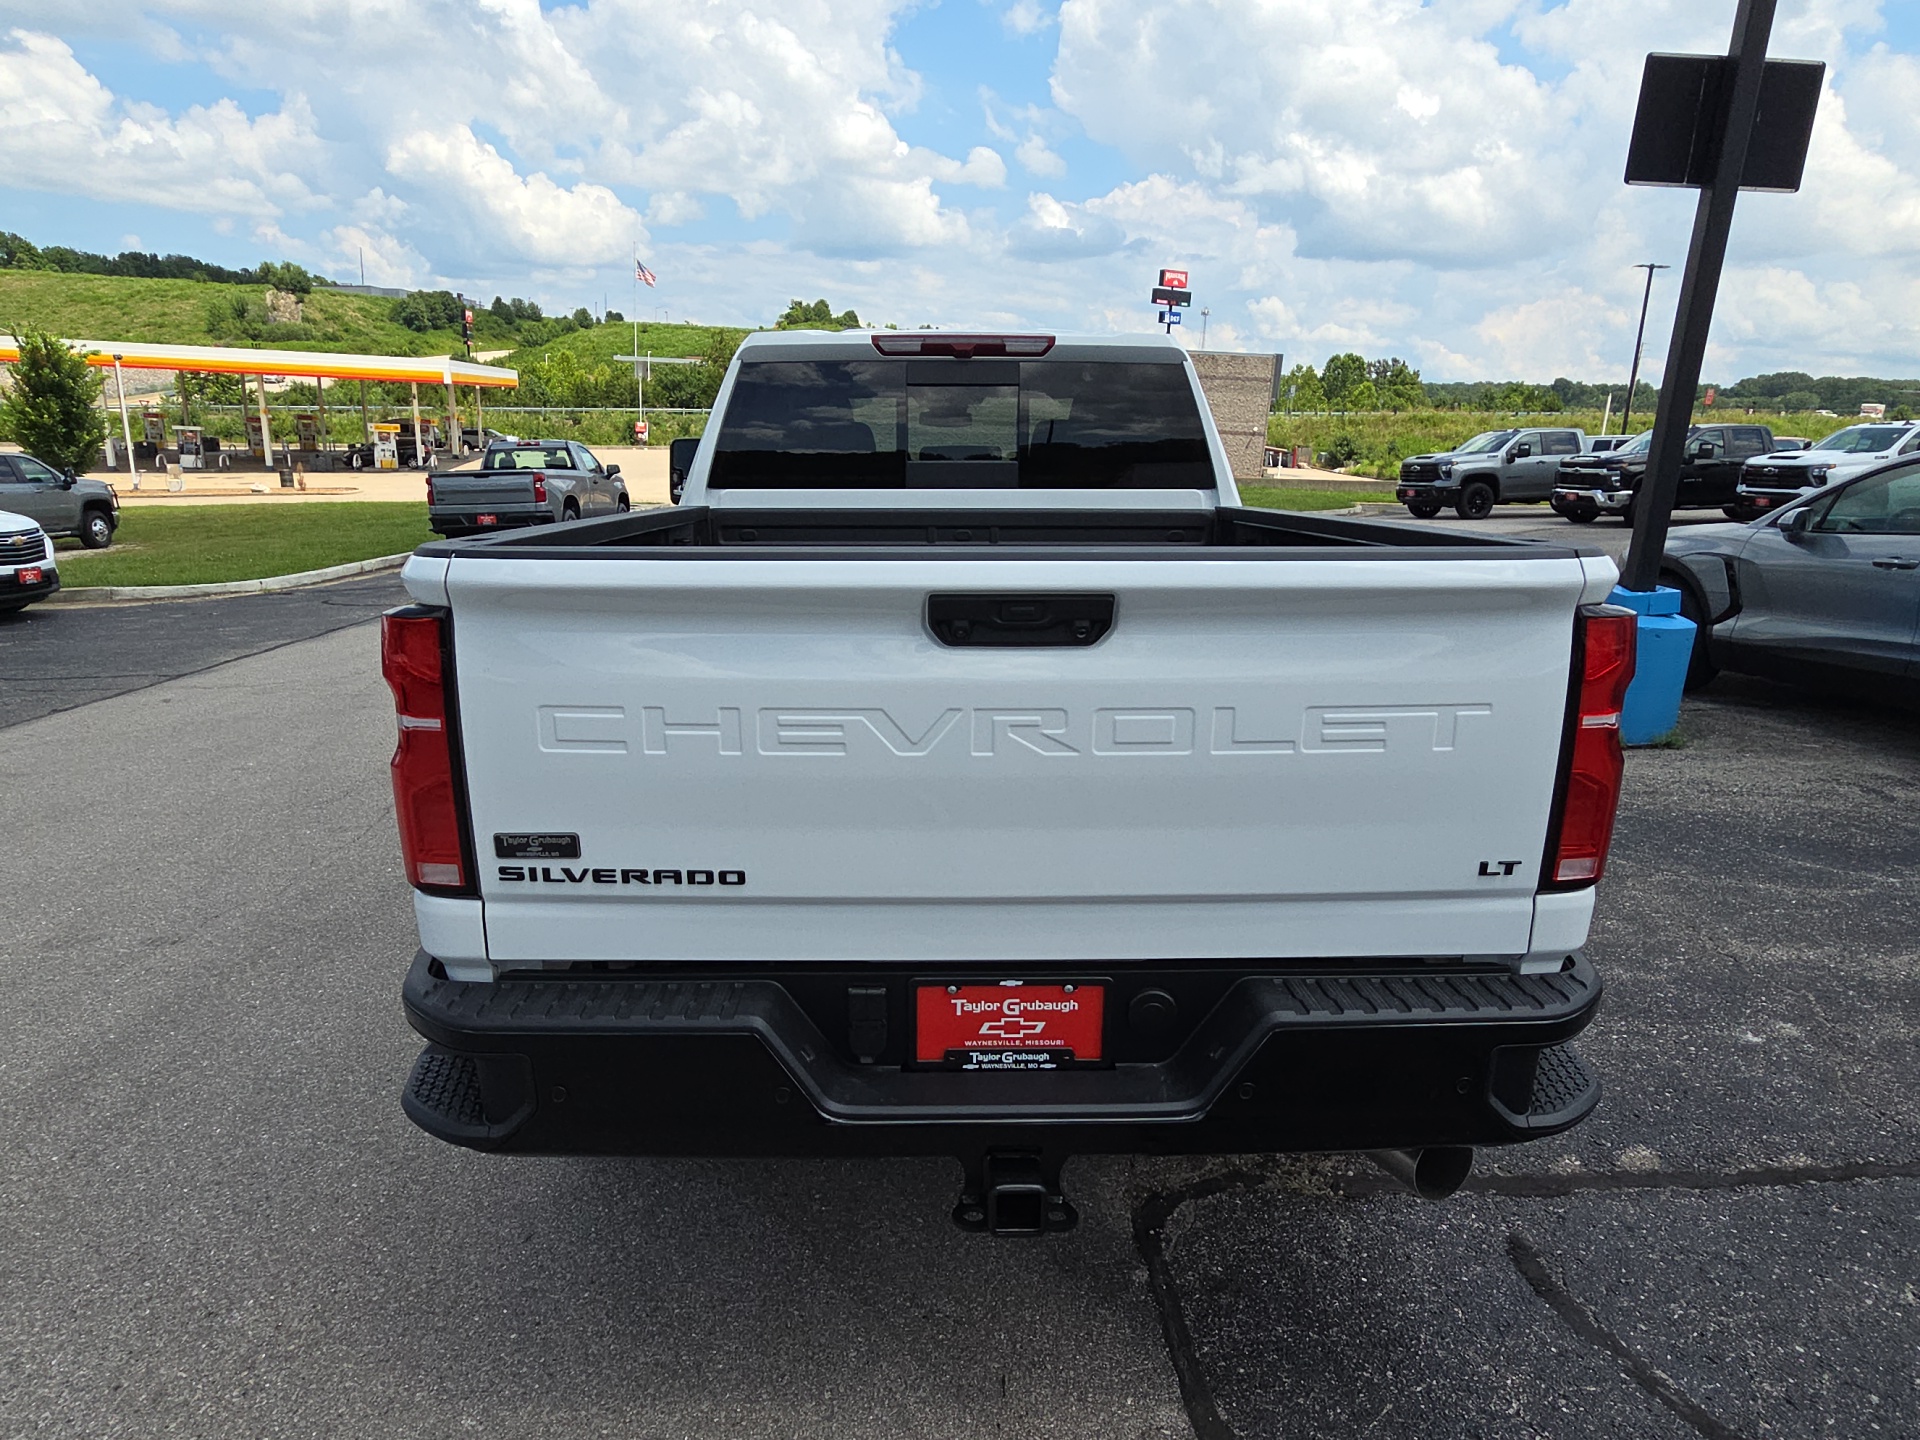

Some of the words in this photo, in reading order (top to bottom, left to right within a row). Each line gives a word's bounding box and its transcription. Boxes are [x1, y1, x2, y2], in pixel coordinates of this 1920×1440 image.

[537, 703, 1493, 757] CHEVROLET
[500, 835, 528, 847] Taylor
[529, 836, 571, 846] Grubaugh
[498, 866, 747, 885] SILVERADO
[1478, 860, 1522, 876] LT
[951, 998, 1000, 1016] Taylor
[1002, 998, 1079, 1016] Grubaugh
[969, 1052, 1001, 1064] Taylor
[1001, 1052, 1050, 1063] Grubaugh
